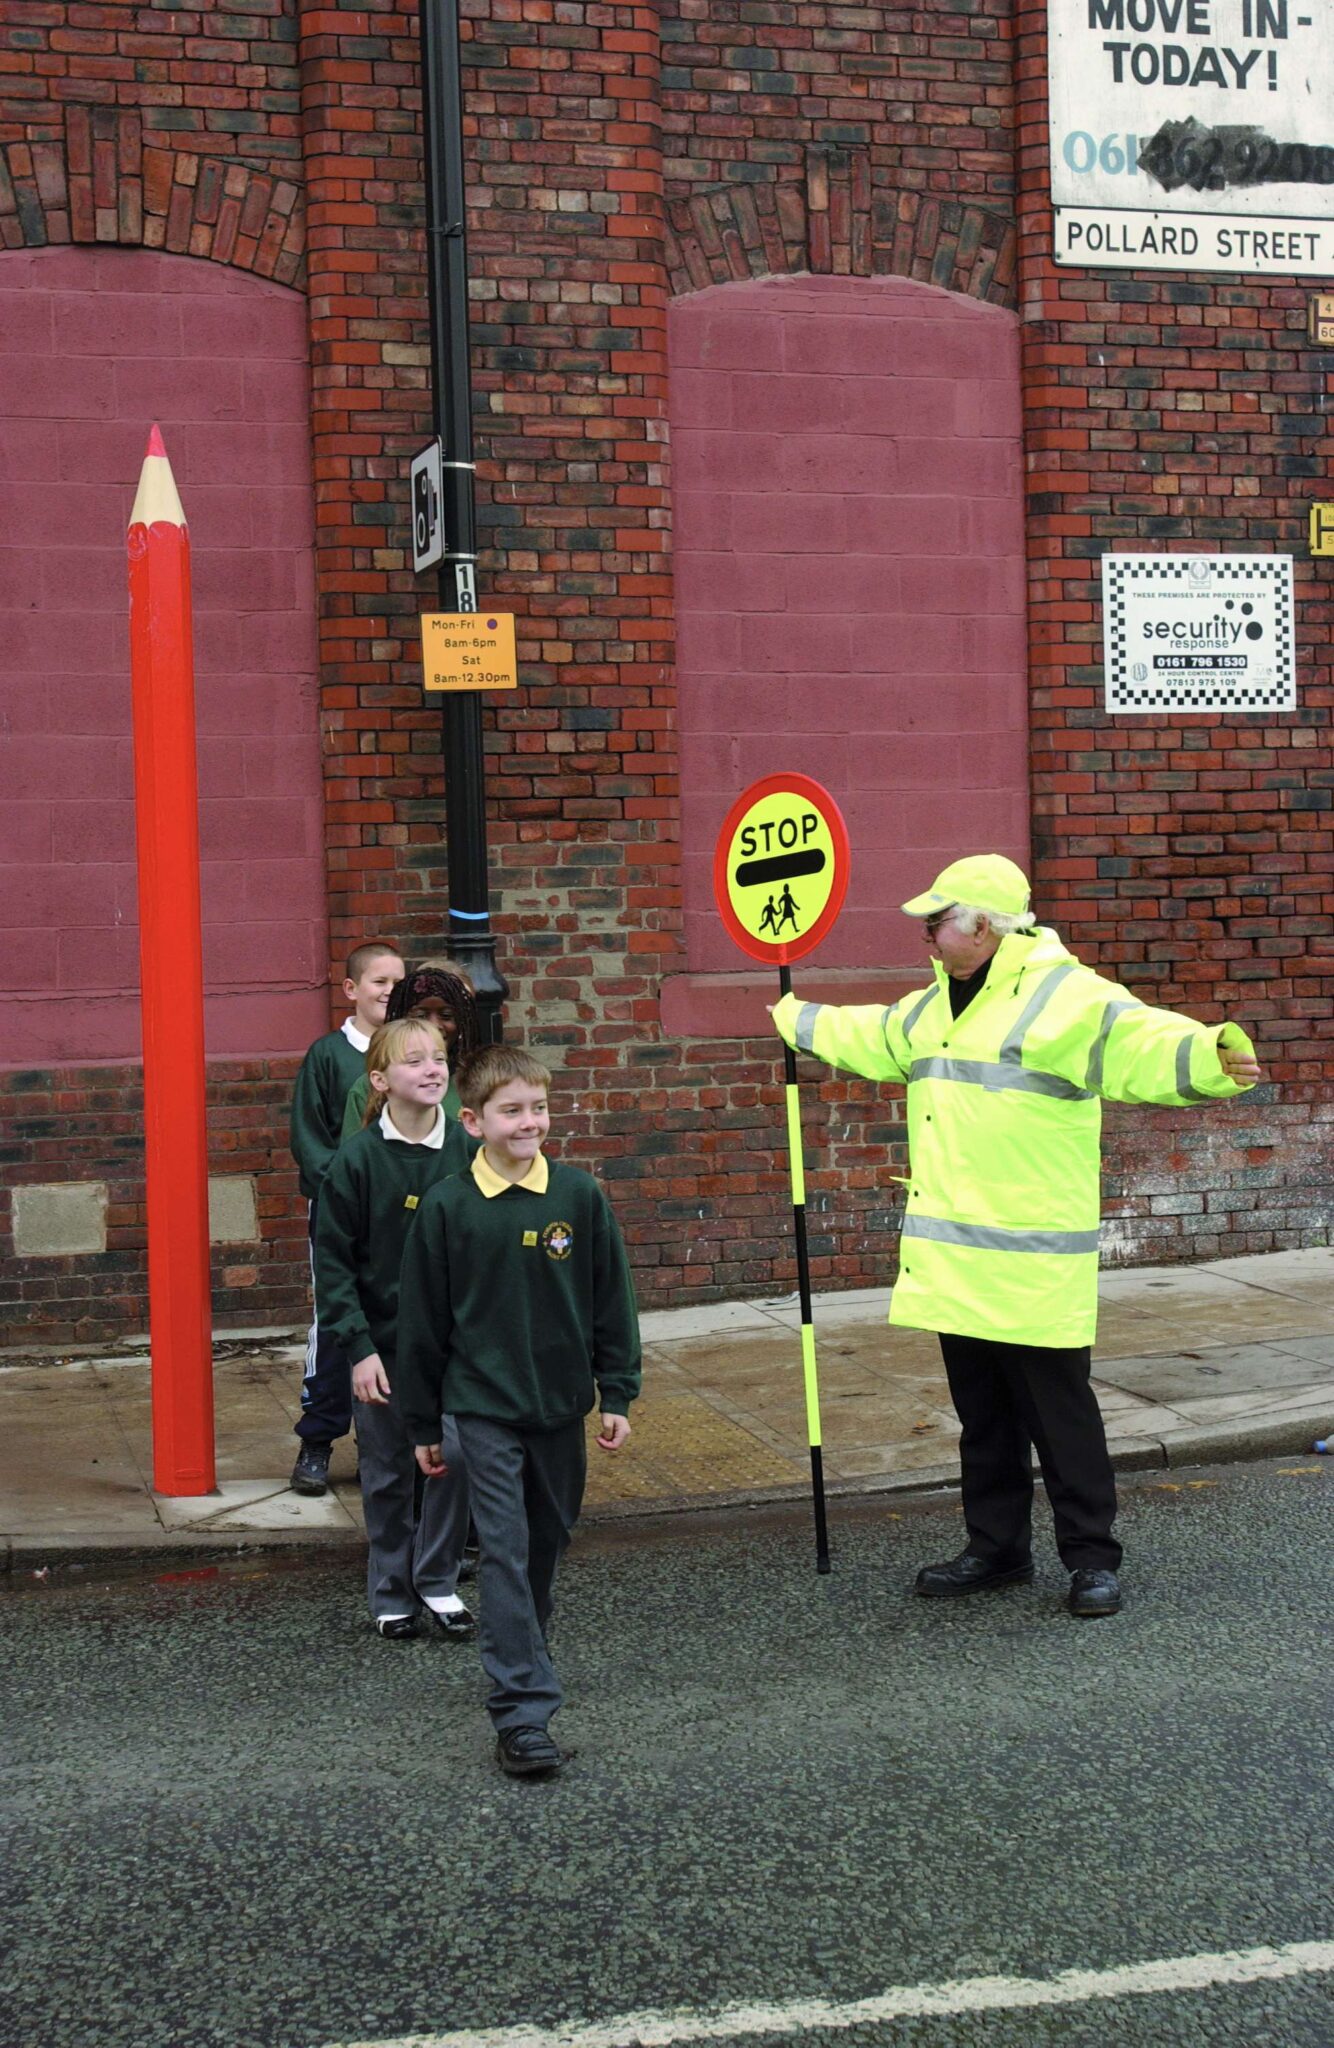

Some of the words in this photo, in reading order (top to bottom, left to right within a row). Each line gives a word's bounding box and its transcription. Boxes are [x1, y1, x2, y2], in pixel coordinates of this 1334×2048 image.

[1088, 0, 1211, 35] MOVE
[1103, 41, 1278, 91] TODAY!
[1068, 222, 1199, 256] POLLARD
[1216, 229, 1321, 262] STREET
[432, 620, 475, 629] Mon-Fri
[1143, 614, 1242, 644] security
[444, 638, 497, 648] 8am-6pm
[1170, 640, 1229, 651] response
[462, 655, 481, 665] Sat
[1157, 657, 1186, 667] 0161
[1191, 657, 1213, 667] 796
[1217, 657, 1246, 667] 1530
[434, 672, 510, 683] 8am-12.30pm
[740, 813, 818, 857] STOP
